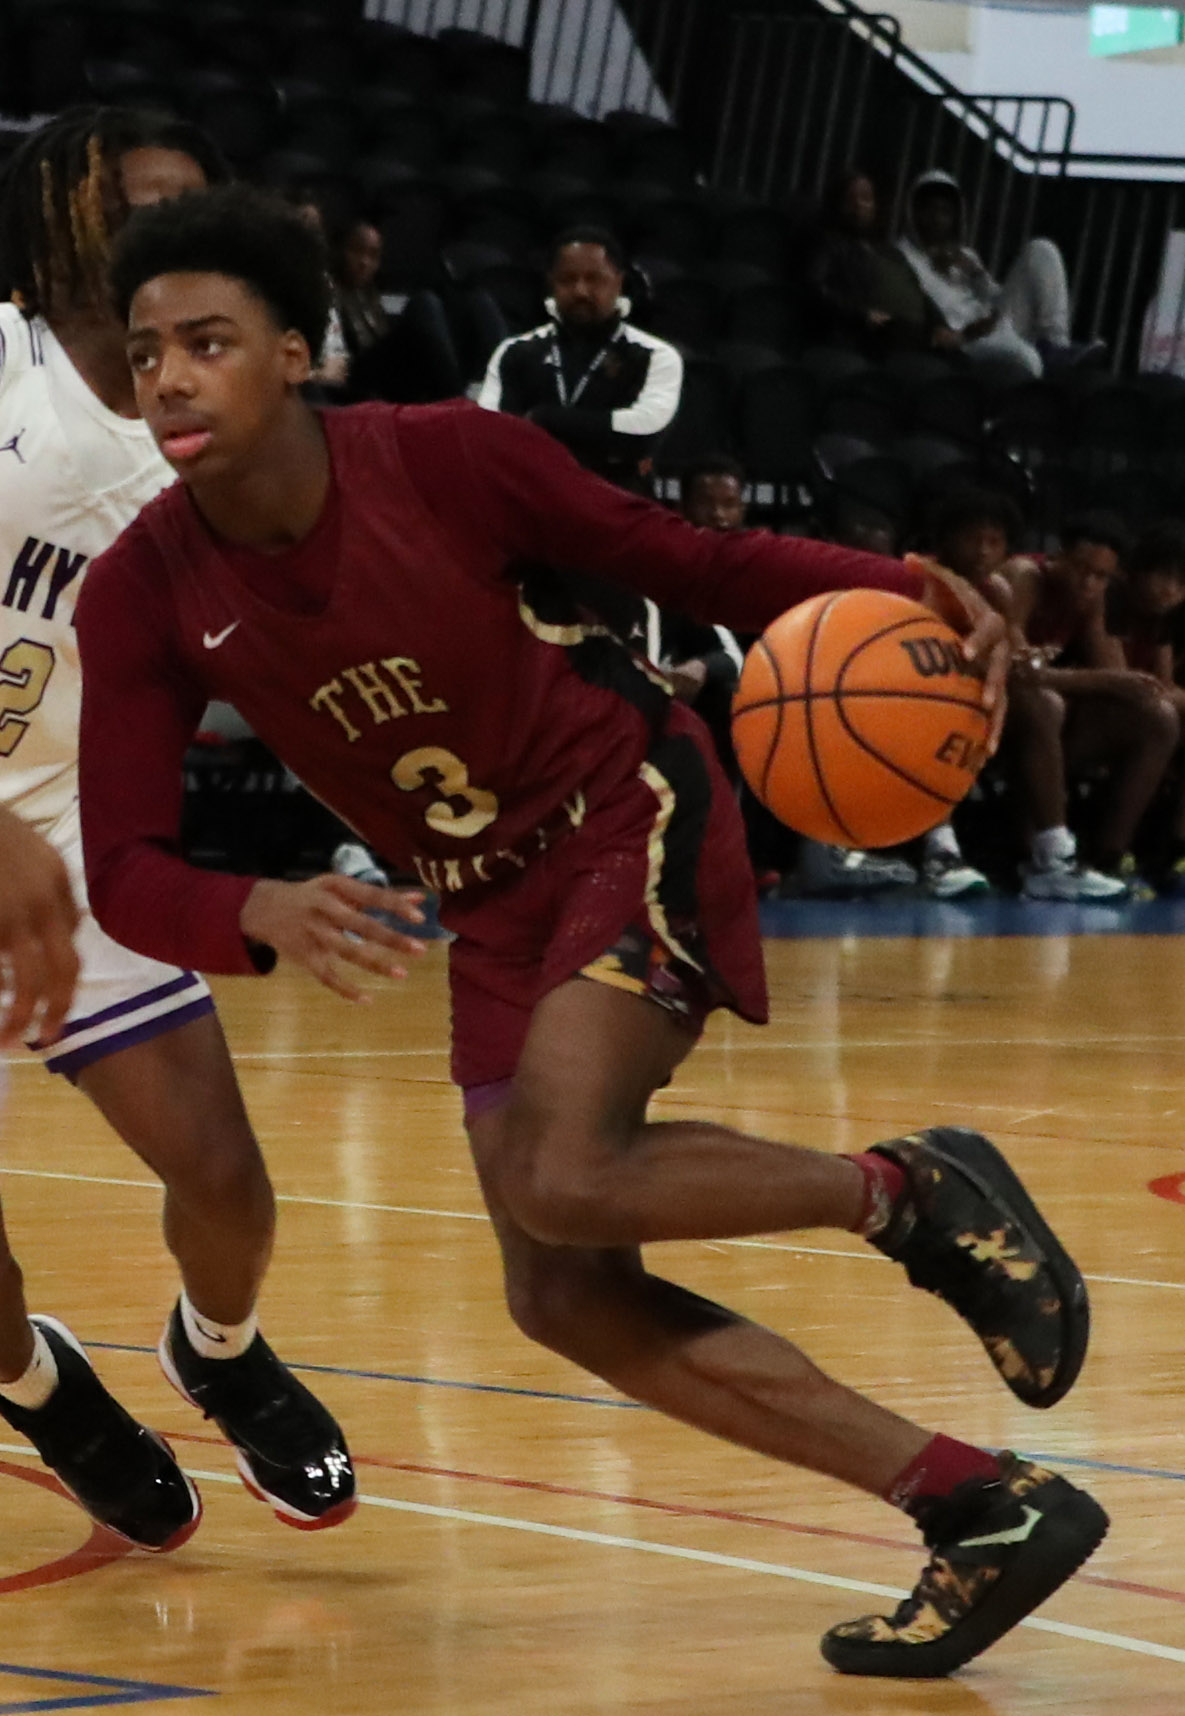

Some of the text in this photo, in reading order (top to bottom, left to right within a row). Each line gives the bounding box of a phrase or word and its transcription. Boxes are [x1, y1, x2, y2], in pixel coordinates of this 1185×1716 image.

[1, 535, 88, 627] HY
[309, 656, 450, 743] THE
[391, 746, 499, 839] 3
